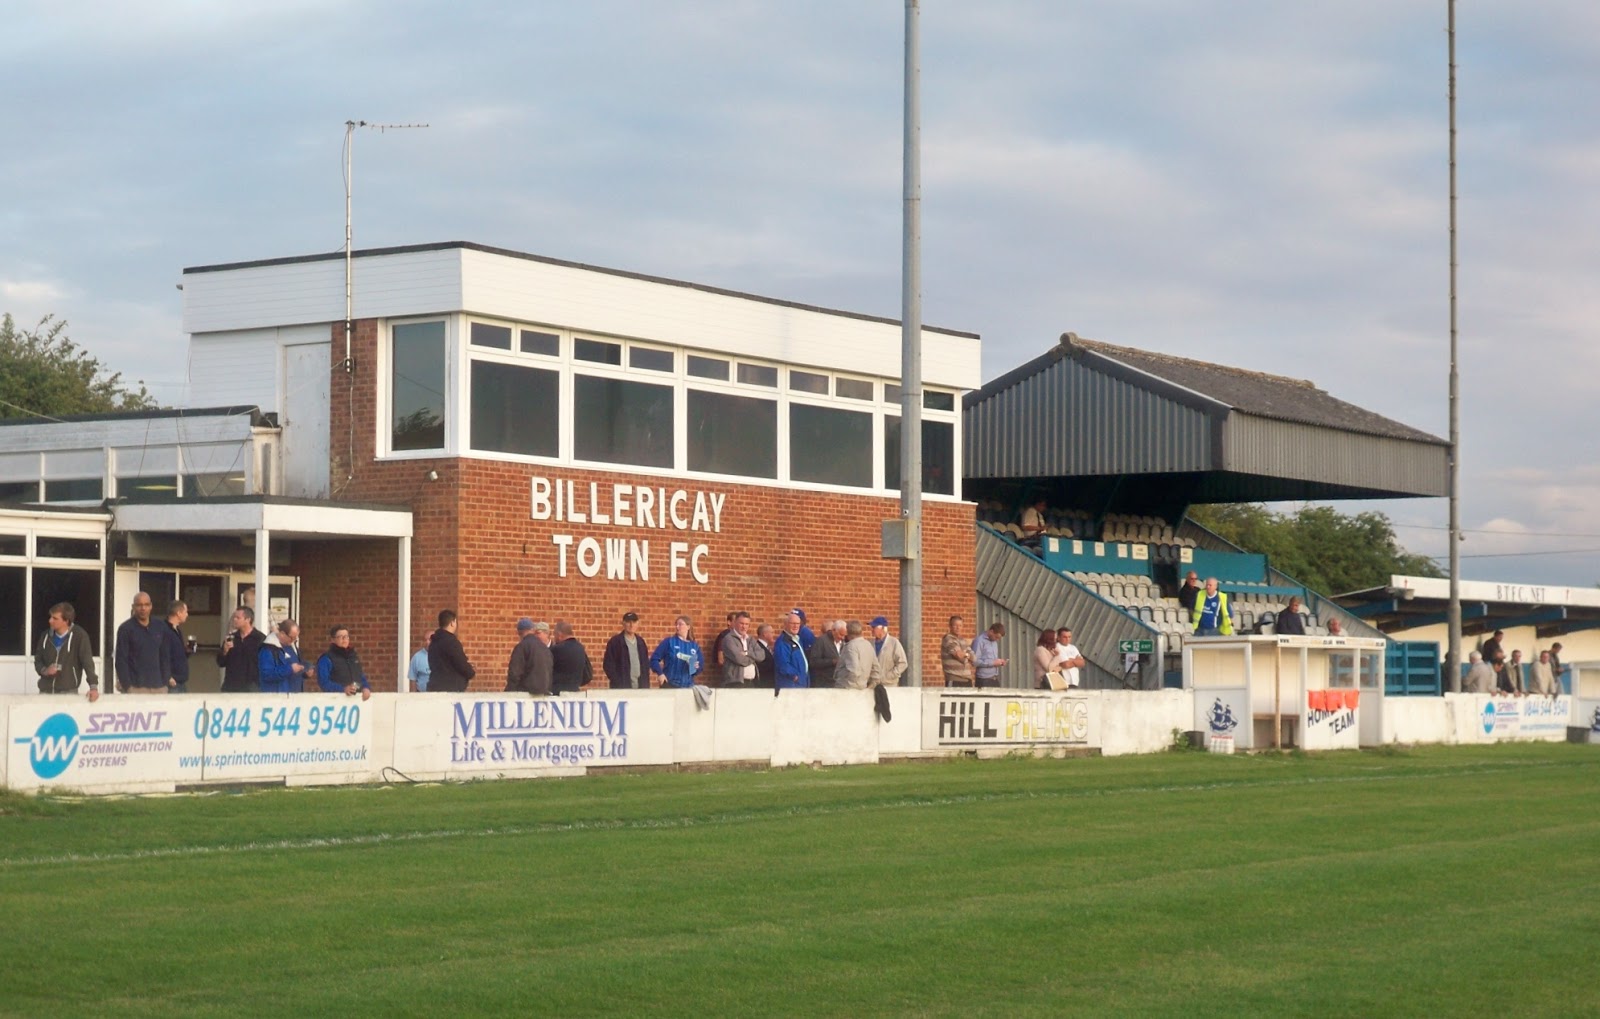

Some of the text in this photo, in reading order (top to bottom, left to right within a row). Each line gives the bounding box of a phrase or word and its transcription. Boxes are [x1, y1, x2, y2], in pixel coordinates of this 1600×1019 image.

[531, 476, 726, 533] BILLERICAY
[552, 534, 709, 584] TOWN FC
[85, 711, 168, 734] SPRINT
[194, 705, 361, 740] 0844 544 9540
[451, 700, 628, 739] MILLENIUM
[938, 701, 1088, 739] HILL PILING
[1308, 709, 1337, 728] HOM
[1329, 709, 1354, 734] TEAM
[81, 740, 173, 755] COMMUNICATION
[179, 745, 368, 770] www.sprintcommunications.co.uk
[451, 737, 628, 764] Life & Mortgages Ltd
[78, 756, 128, 768] SYSTEMS
